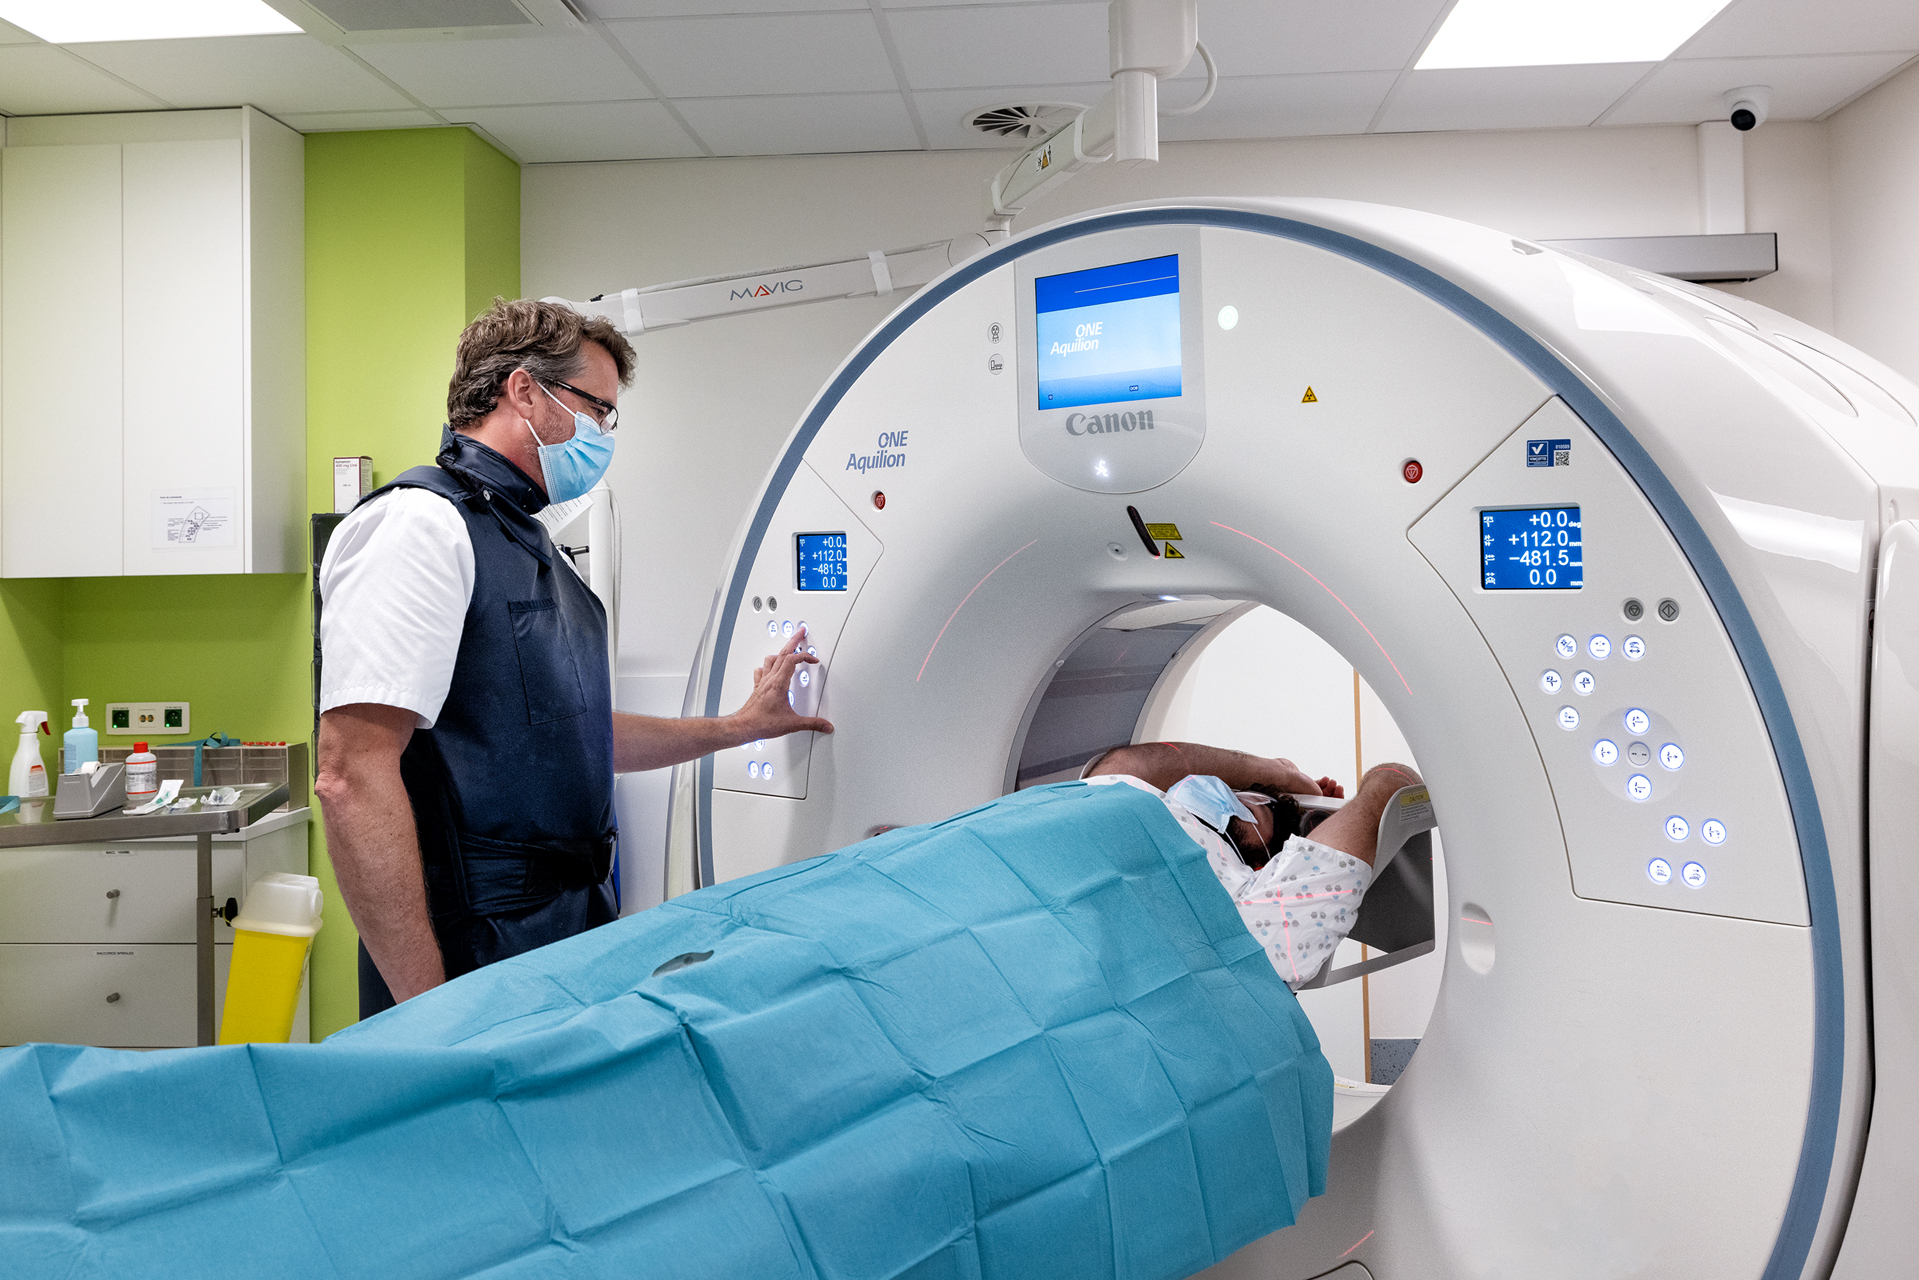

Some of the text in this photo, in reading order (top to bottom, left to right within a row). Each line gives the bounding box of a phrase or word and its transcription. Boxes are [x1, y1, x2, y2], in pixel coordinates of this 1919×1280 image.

[729, 279, 804, 301] MAVIG
[1075, 321, 1104, 338] ONE
[1050, 338, 1099, 357] Aquilion
[1065, 409, 1154, 436] Canon
[878, 430, 909, 449] ONE
[845, 449, 906, 475] Aquilion
[1529, 511, 1568, 528] +0.0
[822, 536, 843, 548] +0.0
[1508, 530, 1569, 547] +112.0
[812, 550, 843, 561] +112.0
[1509, 549, 1569, 566] -481.5
[812, 563, 843, 575] -481.5
[1529, 568, 1557, 585] 0.0
[822, 576, 837, 588] 0.0
